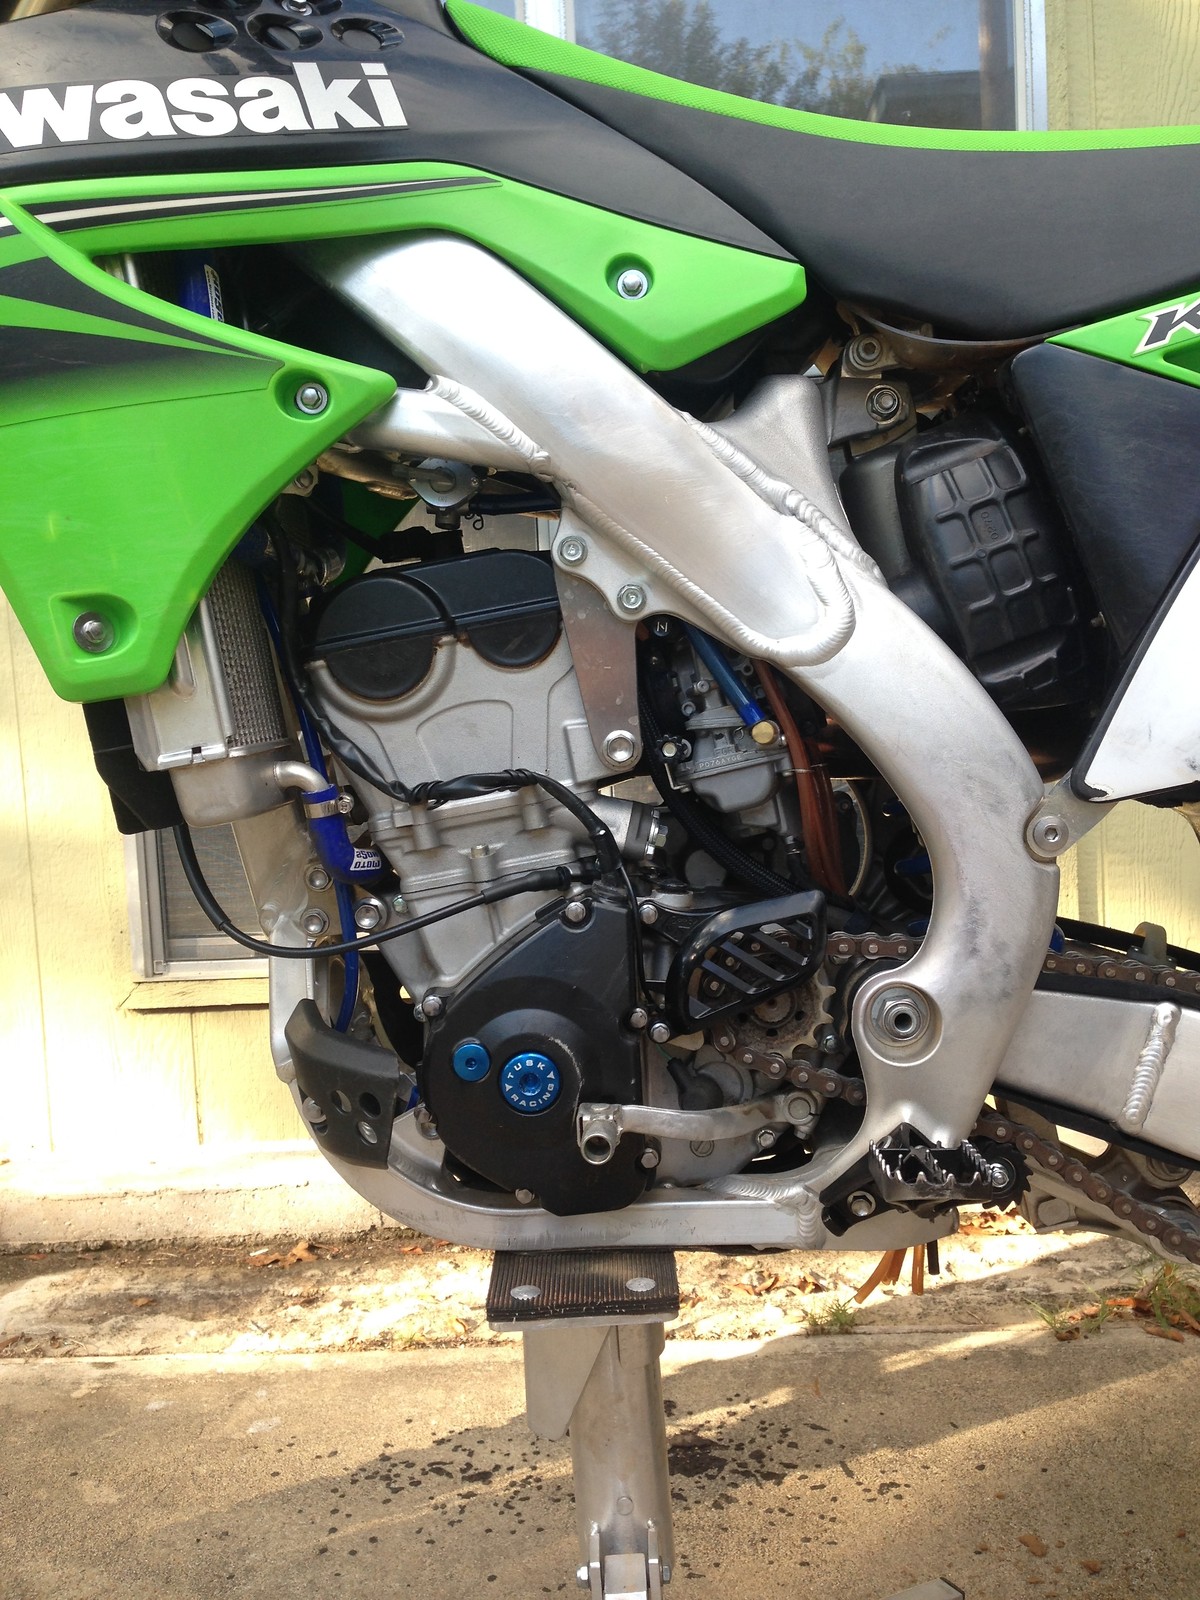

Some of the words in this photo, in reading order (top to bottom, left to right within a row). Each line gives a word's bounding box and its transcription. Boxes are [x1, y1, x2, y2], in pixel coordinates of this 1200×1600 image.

[0, 62, 408, 148] wasaki
[353, 860, 380, 869] MOTO
[507, 1059, 546, 1079] TUSK
[510, 1083, 555, 1107] RACING
